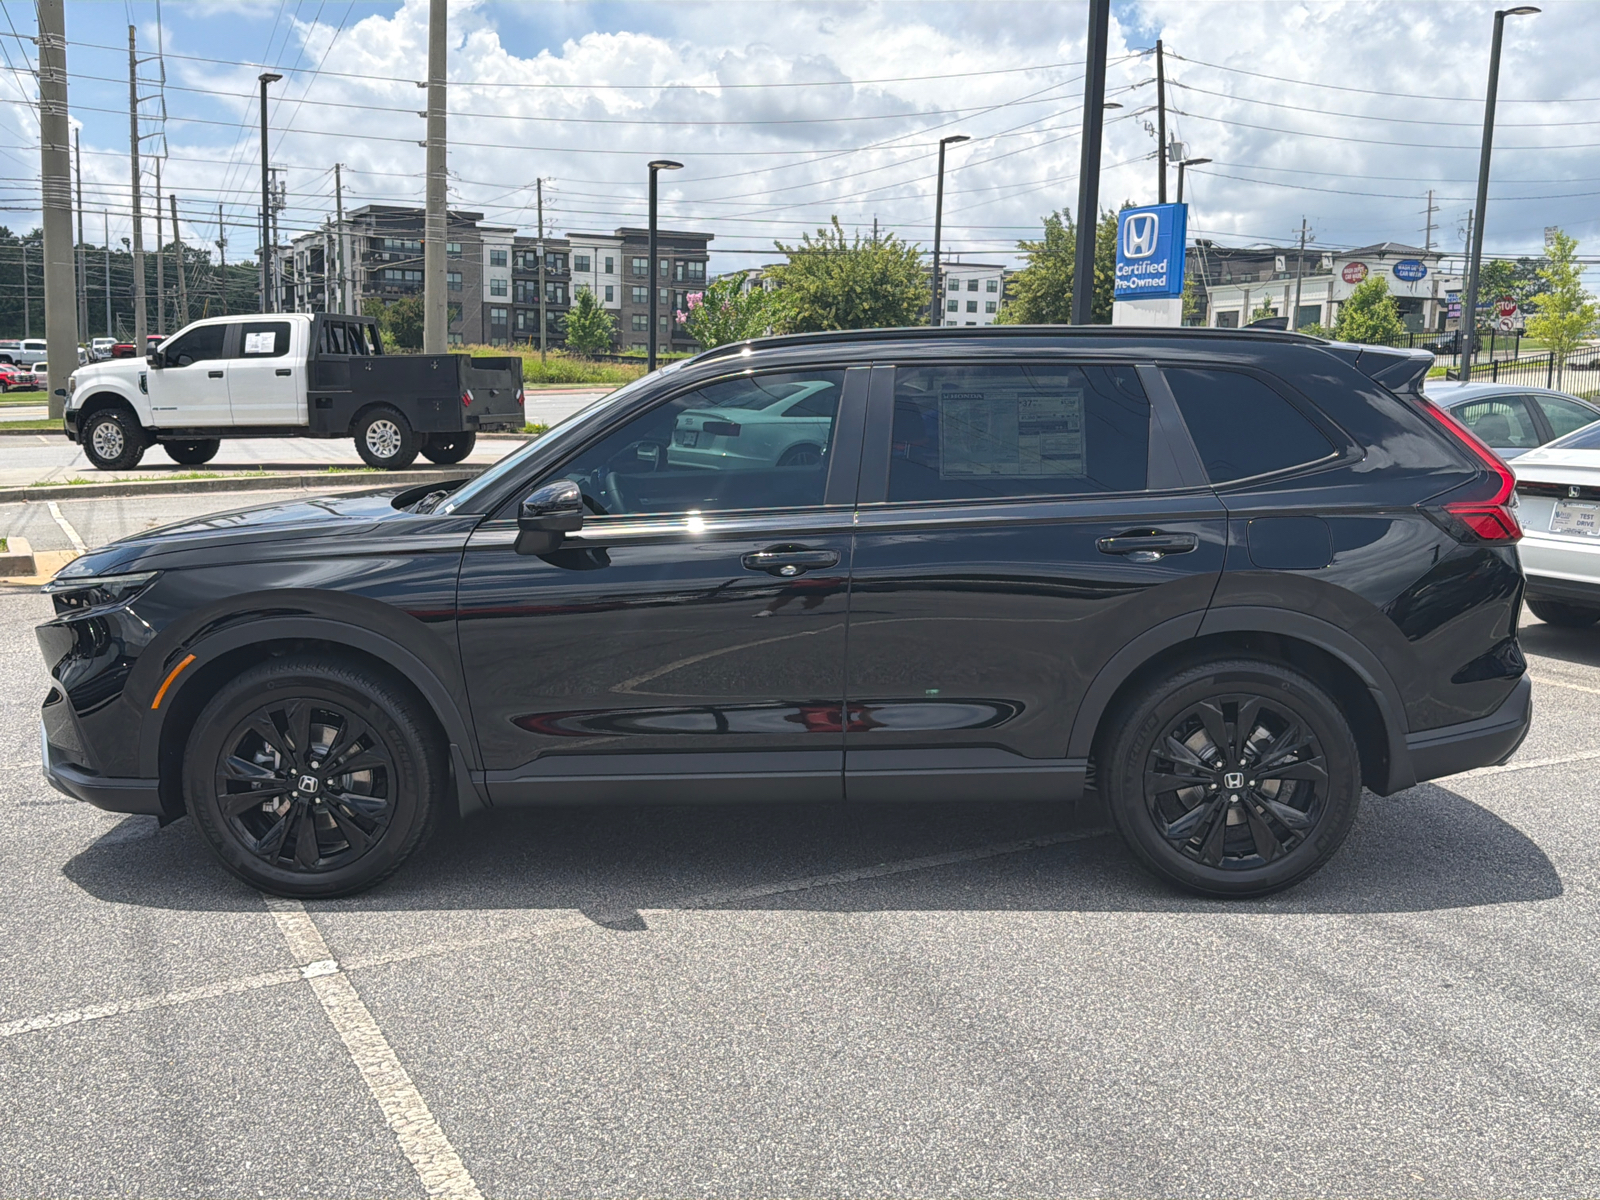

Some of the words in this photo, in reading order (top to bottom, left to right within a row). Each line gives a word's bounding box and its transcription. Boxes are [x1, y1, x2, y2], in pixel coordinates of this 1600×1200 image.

[1116, 258, 1168, 277] Certified
[1115, 274, 1167, 290] Pre-Owned
[1496, 301, 1516, 311] STOP
